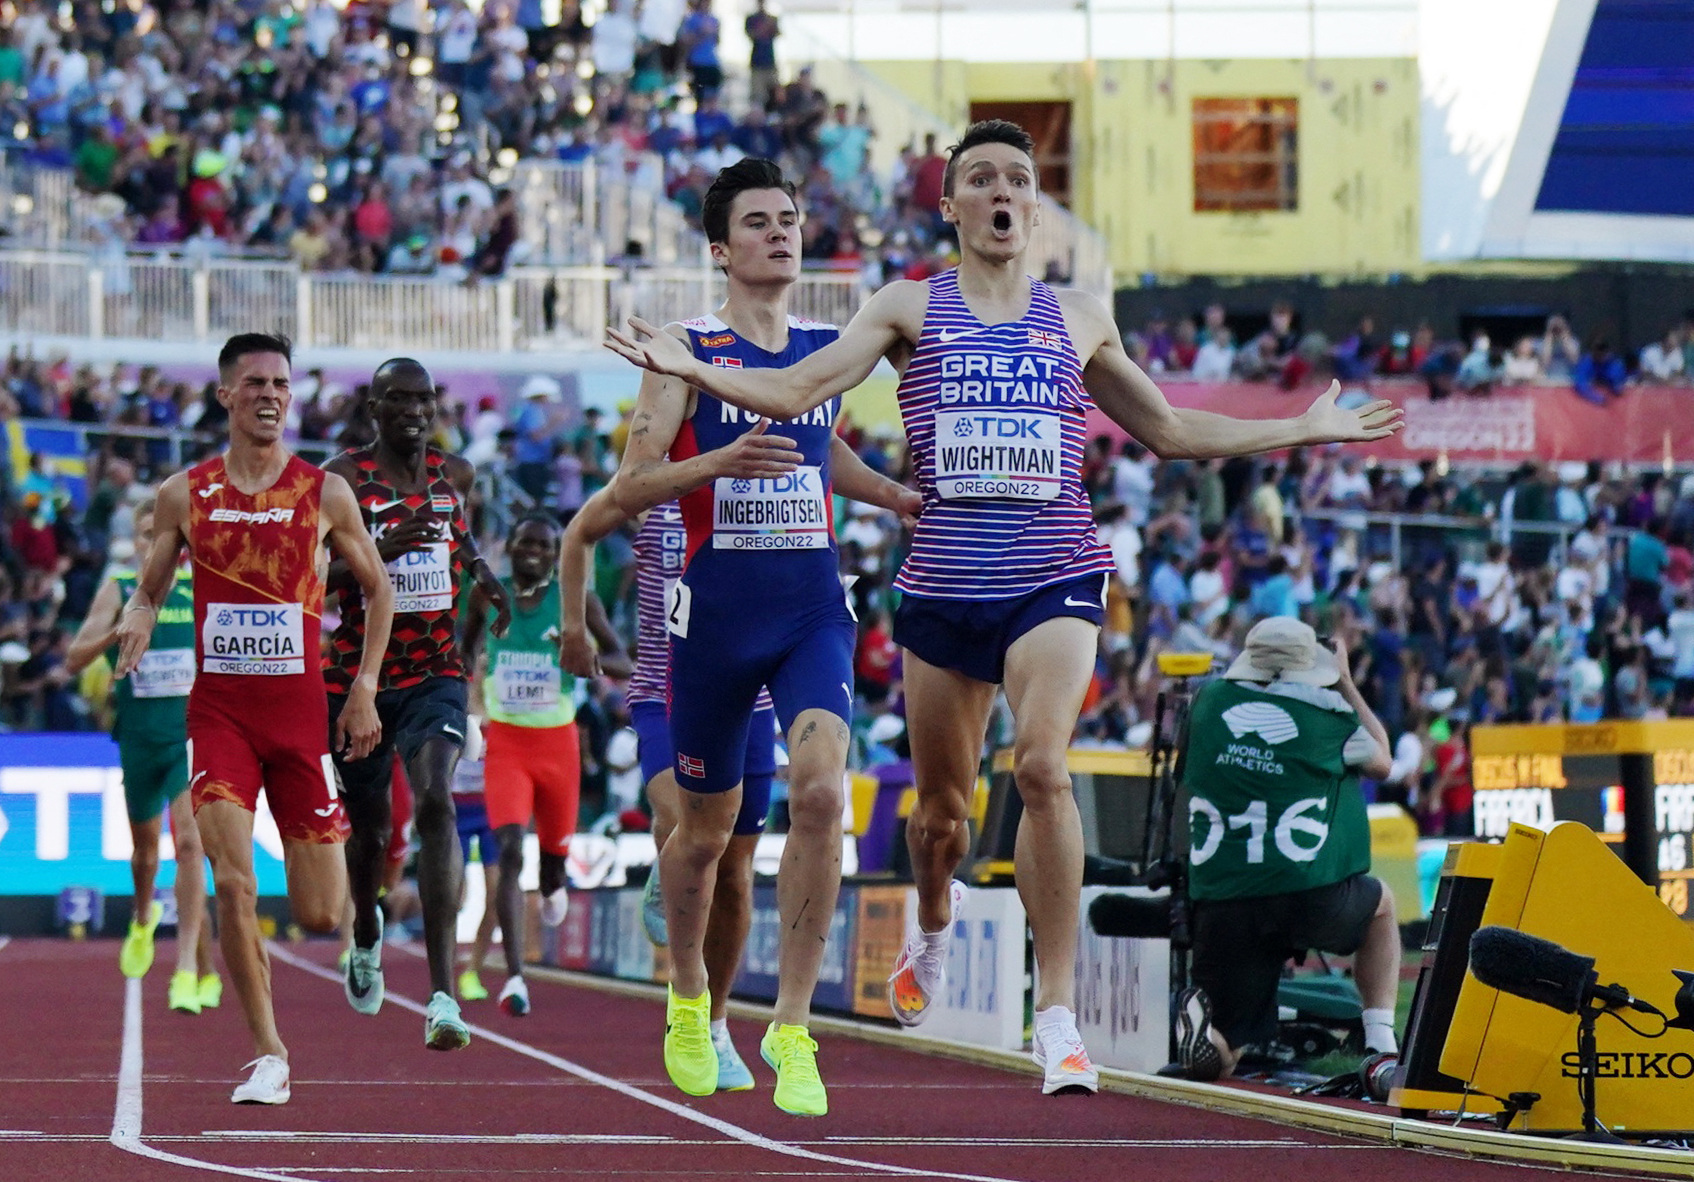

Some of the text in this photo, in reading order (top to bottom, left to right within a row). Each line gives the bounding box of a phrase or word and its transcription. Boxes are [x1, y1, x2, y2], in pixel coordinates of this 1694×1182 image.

[941, 355, 1059, 379] GREAT
[940, 380, 1059, 406] BRITAIN
[974, 417, 1043, 439] TDK
[942, 446, 1054, 474] WIGHTMAN
[954, 481, 1040, 496] OREGON22
[209, 507, 295, 524] ESPAÑA
[718, 499, 823, 525] INGEBRIGTSEN
[733, 536, 813, 549] OREGON22
[233, 610, 288, 626] TDK
[213, 632, 295, 655] GARCÍA
[219, 661, 288, 673] OREGON22
[1227, 743, 1275, 760] WORLD
[1215, 753, 1284, 775] ATHLETICS
[1189, 796, 1329, 866] 016
[1561, 1052, 1694, 1079] SEIKO
